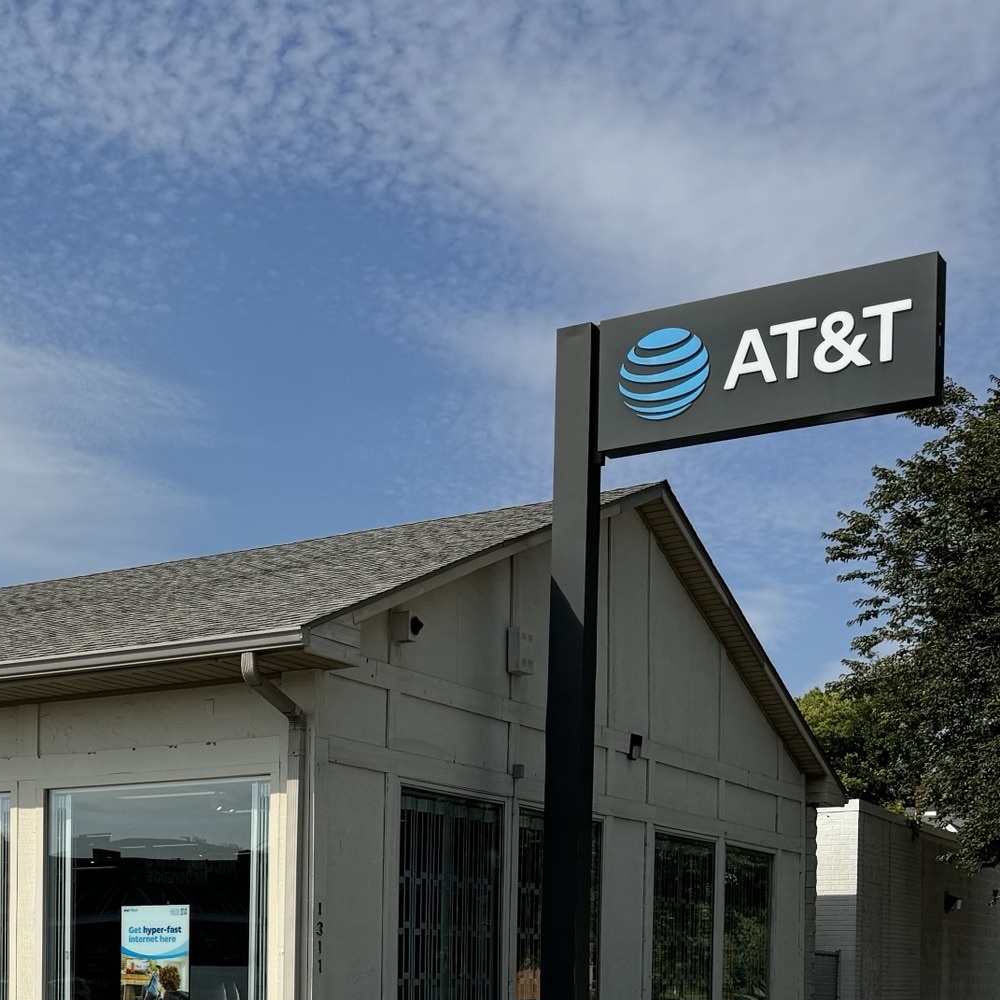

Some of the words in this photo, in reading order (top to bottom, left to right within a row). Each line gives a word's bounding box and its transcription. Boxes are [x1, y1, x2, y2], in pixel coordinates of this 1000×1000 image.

[723, 298, 912, 391] AT&T
[142, 926, 182, 936] hyper-fast
[128, 935, 158, 943] internet
[160, 935, 176, 943] here
